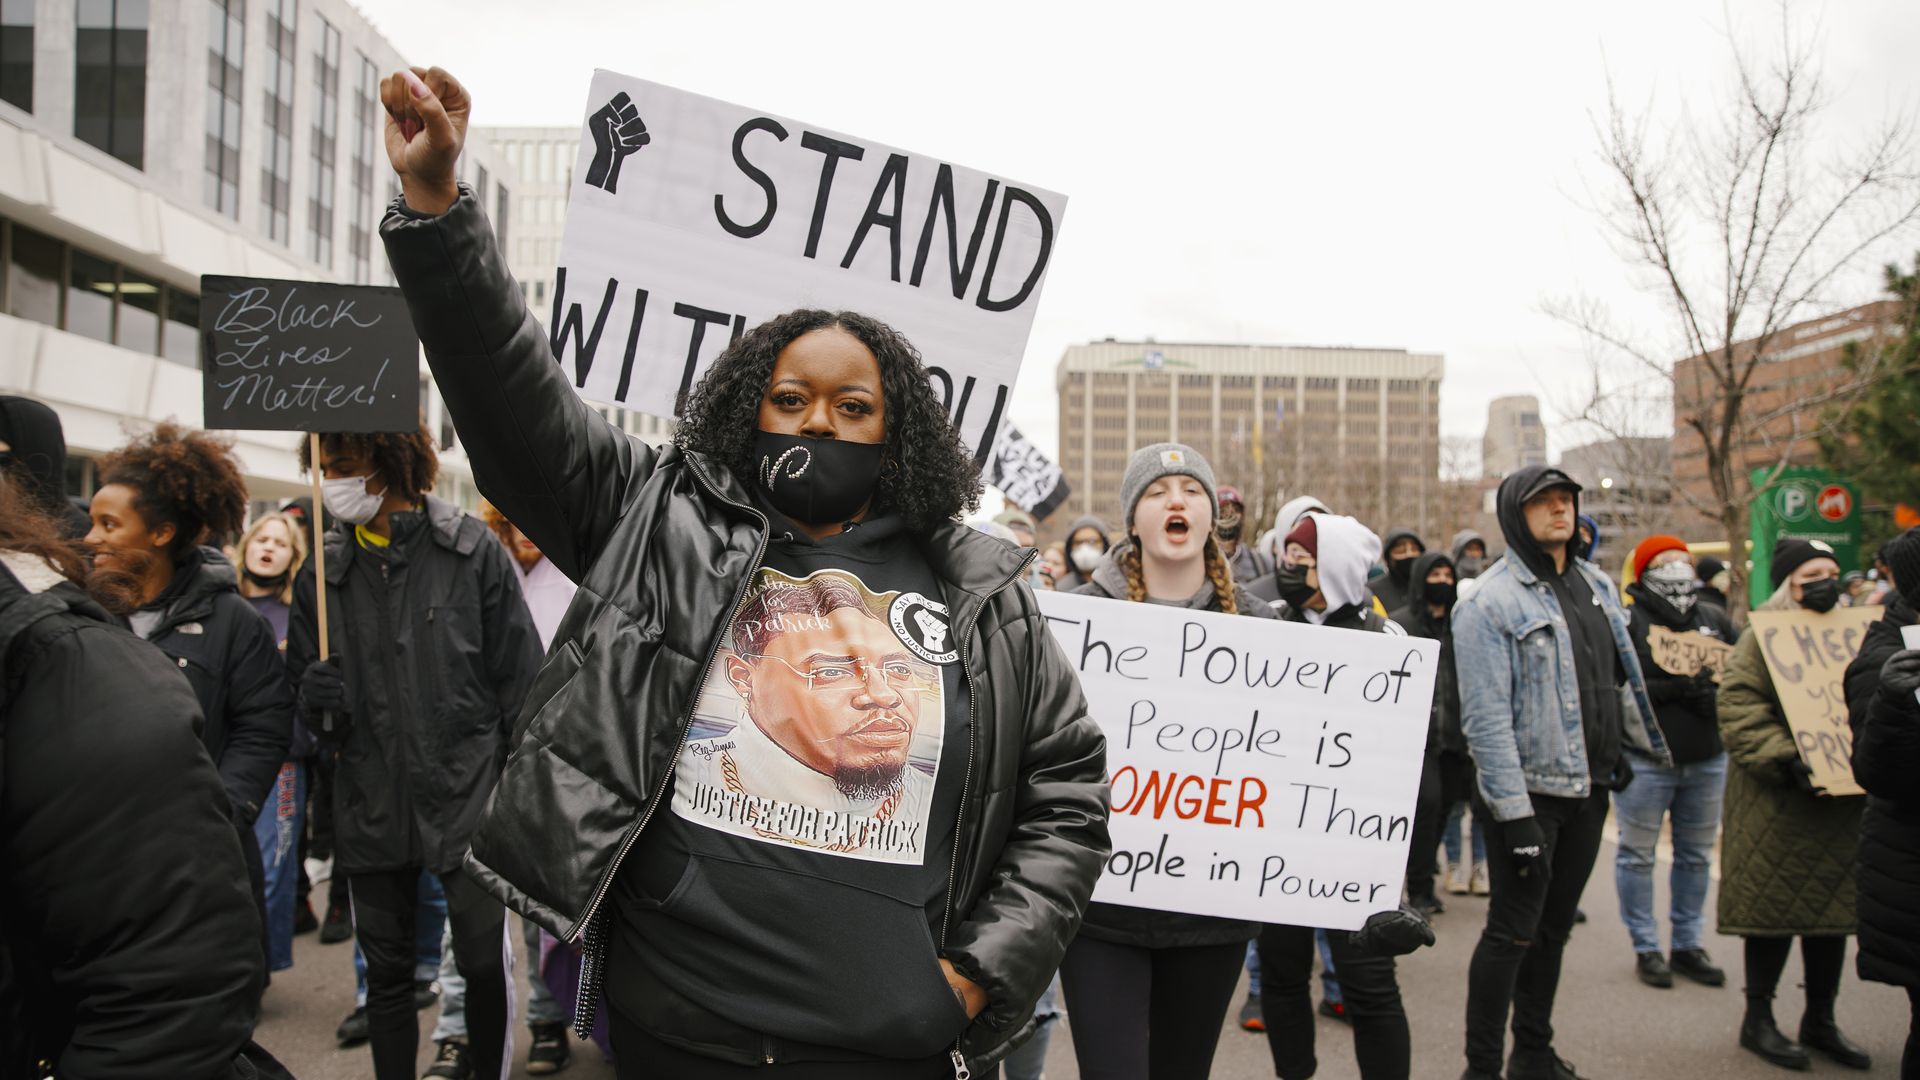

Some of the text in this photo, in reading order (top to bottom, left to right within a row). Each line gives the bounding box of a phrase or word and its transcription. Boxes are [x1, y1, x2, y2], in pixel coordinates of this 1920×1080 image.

[714, 117, 1053, 312] STAND
[214, 286, 382, 333] Black
[215, 335, 352, 369] Lives
[550, 266, 1008, 472] WIT OU
[1784, 489, 1806, 517] P
[736, 610, 832, 642] Patrick
[895, 595, 933, 612] SAY HIS
[894, 622, 955, 662] NO JUSTICE NO
[1179, 621, 1348, 695] Power
[1362, 649, 1423, 704] of
[1764, 619, 1872, 684] CHEC
[1126, 699, 1353, 776] People is
[688, 782, 920, 854] JUSTICE FOR PATRICK
[1110, 765, 1410, 843] ONGER Than
[1107, 833, 1387, 905] ople in Power
